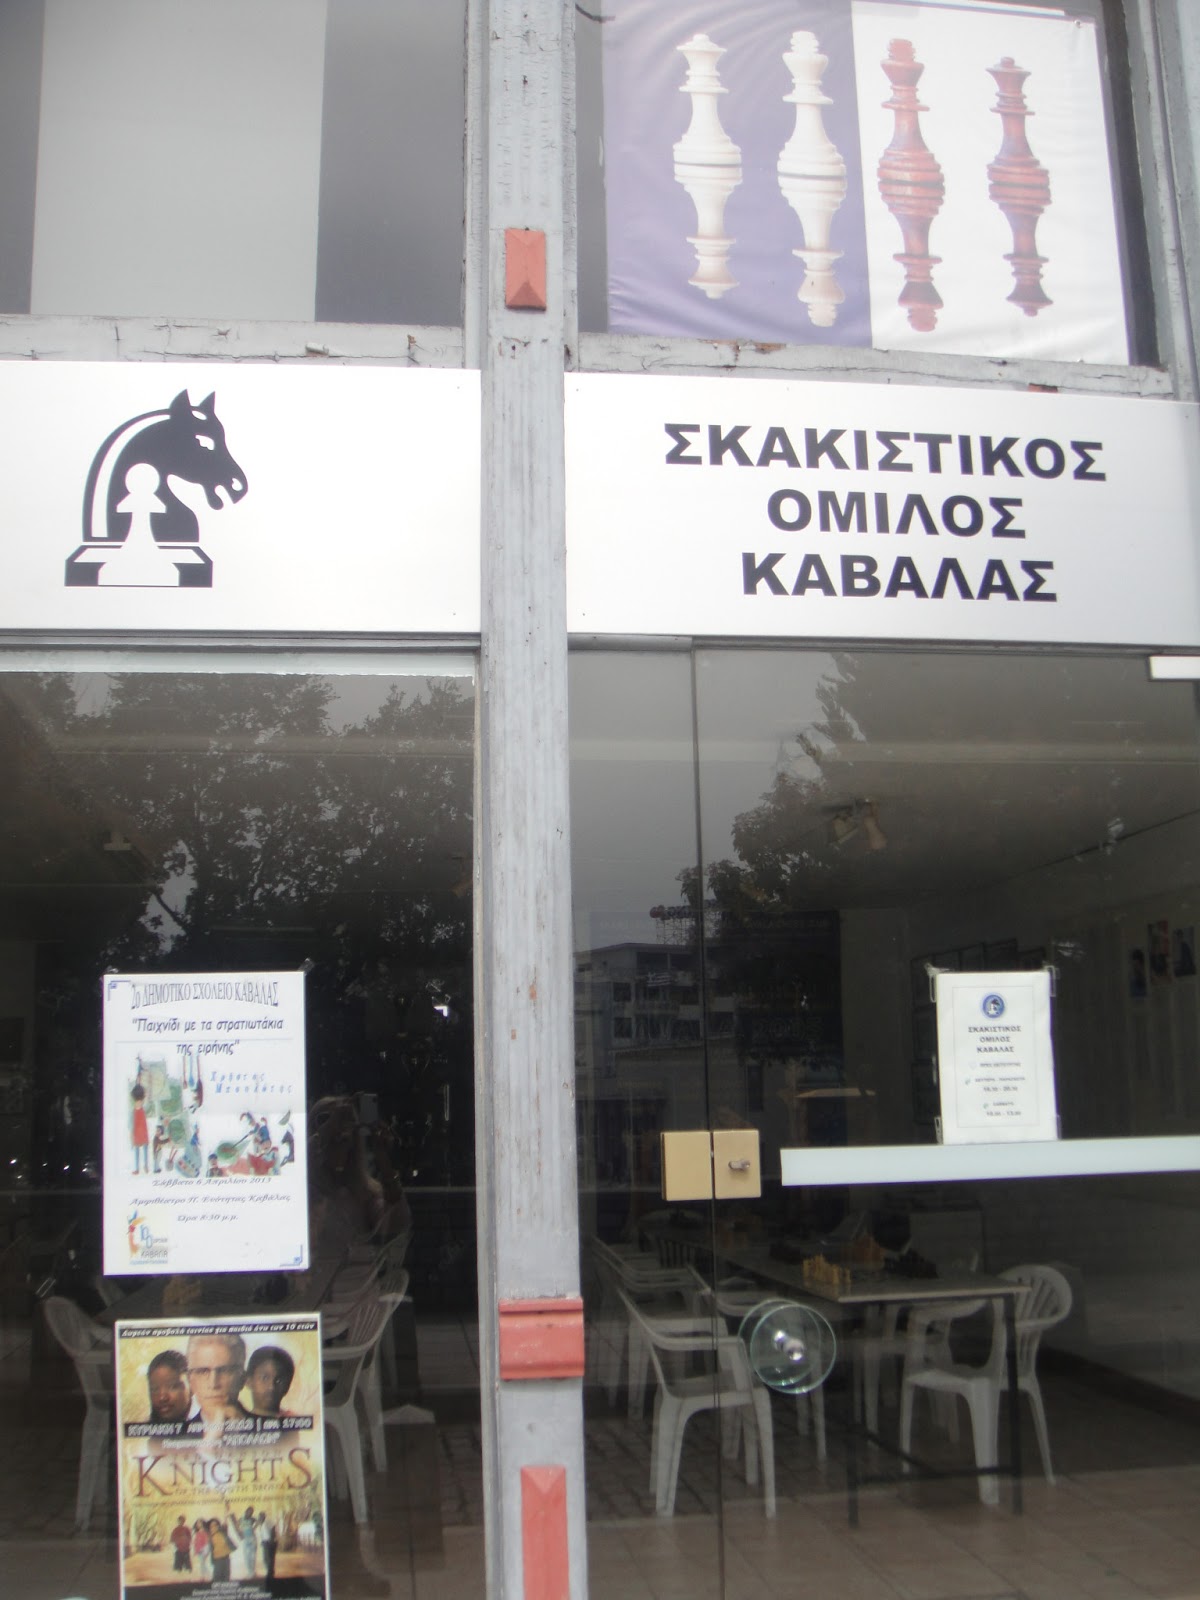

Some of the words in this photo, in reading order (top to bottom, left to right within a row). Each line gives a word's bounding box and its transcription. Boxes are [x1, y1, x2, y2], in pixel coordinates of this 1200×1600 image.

[664, 423, 1107, 482] ΣΚΑΚΙΣΤΙΚΟΣ
[767, 488, 1027, 539] ΟΜΙΛΟΣ
[742, 552, 1058, 602] ΚΑΒΑΛΑΣ
[142, 982, 191, 1007] ΔΗΜΟΤΙΚΟ
[192, 982, 233, 1000] ΣΧΟΛΕΙΟ
[234, 981, 279, 1008] ΚΑΒΑΛΑΣ
[176, 1043, 193, 1056] της
[184, 1021, 196, 1033] με
[201, 1021, 212, 1030] τα
[216, 1017, 284, 1032] στρατιωτάκια
[132, 1447, 312, 1498] KNIGHTS
